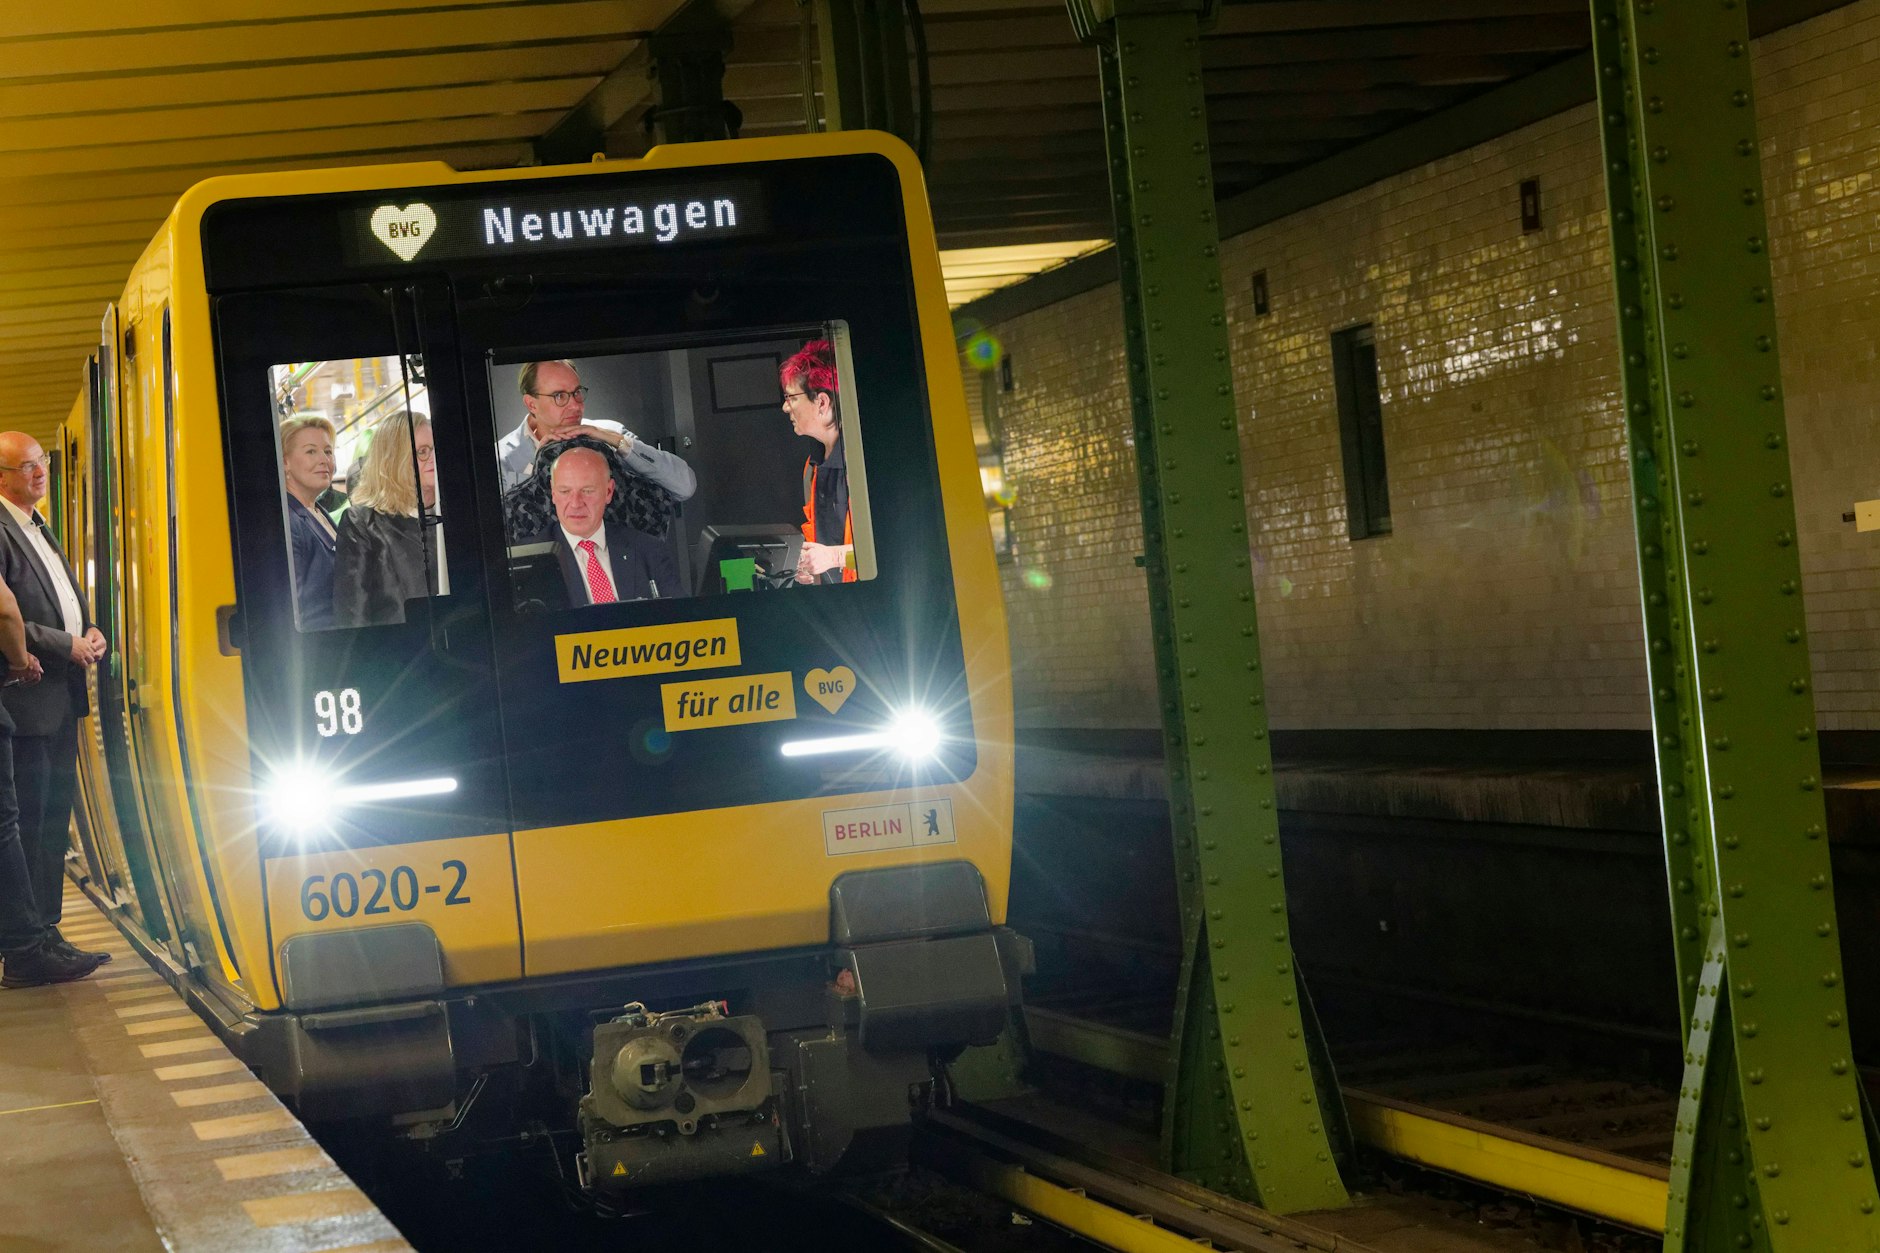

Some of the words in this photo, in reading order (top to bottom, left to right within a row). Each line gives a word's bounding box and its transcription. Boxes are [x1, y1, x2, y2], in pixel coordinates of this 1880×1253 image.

[388, 220, 421, 238] BVG
[483, 198, 737, 245] Neuwagen
[571, 636, 727, 670] Neuwagen
[677, 692, 719, 719] für
[728, 684, 781, 713] alle
[818, 680, 844, 695] BVG
[314, 688, 364, 737] 98
[835, 818, 903, 841] BERLIN
[300, 859, 471, 921] 6020-2
